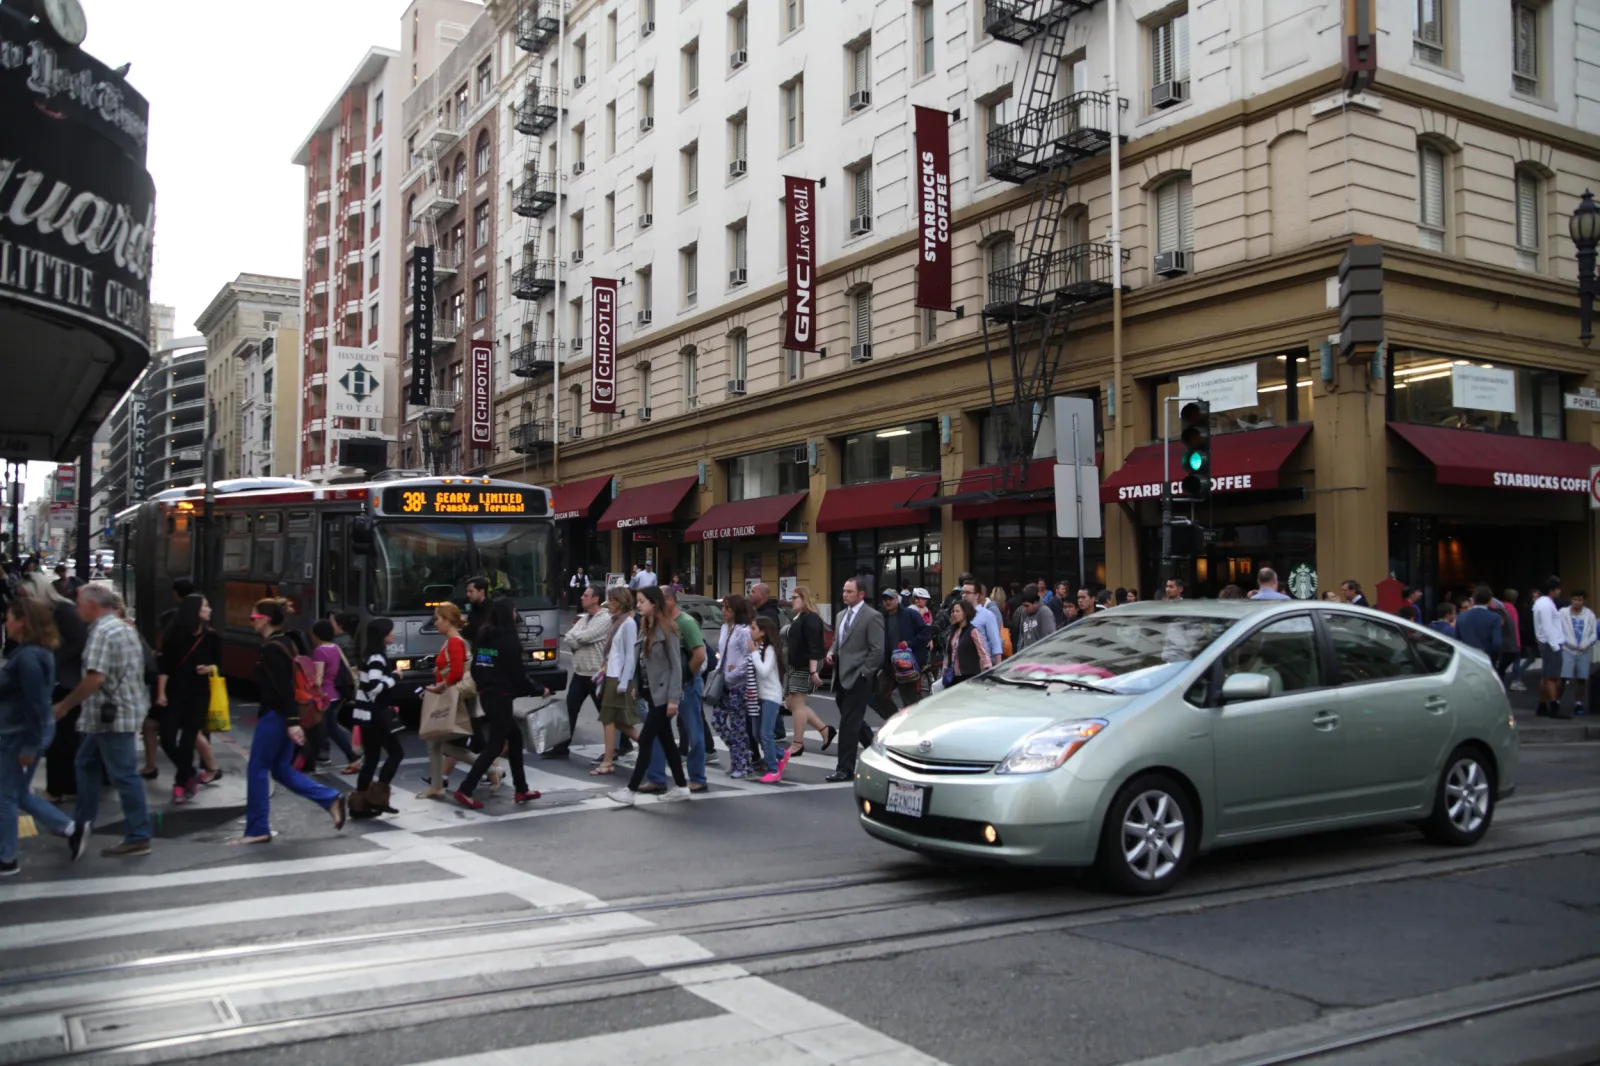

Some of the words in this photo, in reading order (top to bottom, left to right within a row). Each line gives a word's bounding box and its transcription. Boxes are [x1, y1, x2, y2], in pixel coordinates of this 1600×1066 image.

[922, 151, 936, 262] STARBUCKS
[936, 173, 948, 243] COFFEE
[796, 224, 810, 263] Live
[419, 255, 427, 340] SPAULDING
[794, 264, 810, 343] GNC
[598, 292, 611, 377] CHIPOTLE
[338, 351, 380, 362] HANDLERY
[418, 349, 426, 396] HOTEL
[477, 352, 488, 420] CHIPOTLE
[336, 402, 381, 414] HOTEL
[134, 402, 147, 490] PARKING
[436, 492, 471, 503] GEARY
[479, 492, 523, 503] LIMITED
[1118, 481, 1183, 500] STARBC
[1493, 471, 1559, 490] STARBUCKS
[434, 502, 479, 513] Transbay
[483, 502, 525, 512] Terminal
[617, 518, 632, 529] GNC
[702, 528, 718, 540] CABLE
[719, 527, 731, 538] CAR
[732, 525, 756, 537] TAILORS
